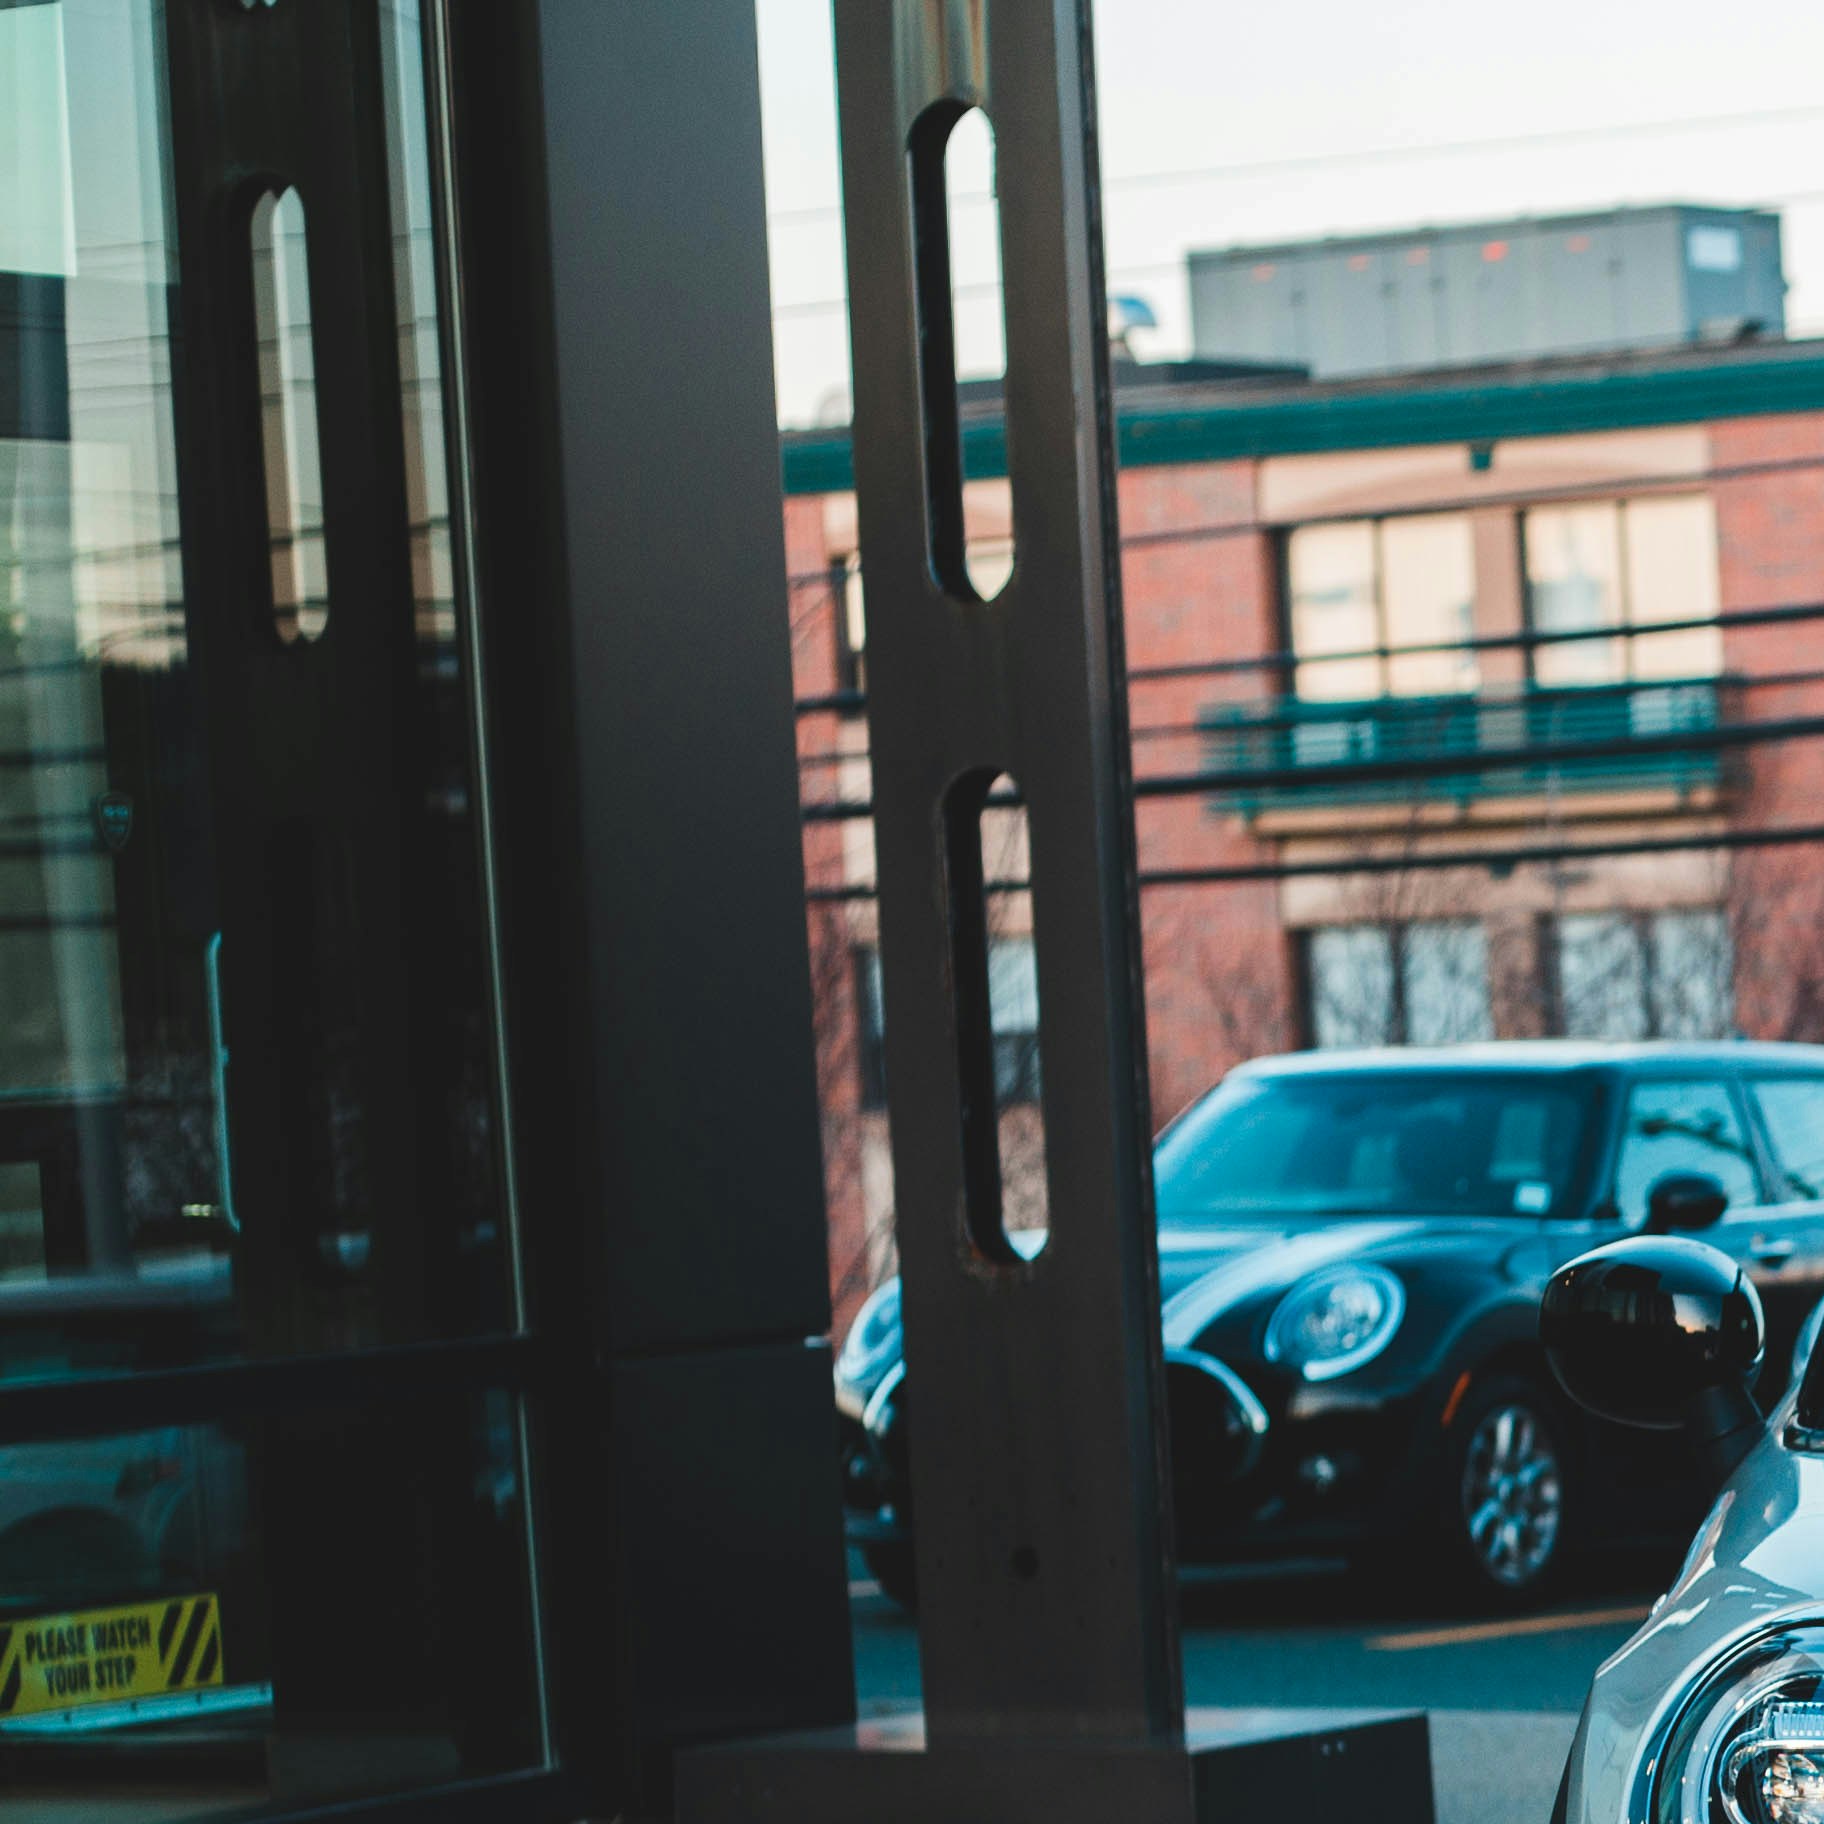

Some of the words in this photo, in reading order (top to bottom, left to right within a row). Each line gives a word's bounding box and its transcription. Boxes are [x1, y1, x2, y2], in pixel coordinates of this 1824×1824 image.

[25, 1622, 88, 1663] PLEASE
[91, 1615, 150, 1652] WATCH
[44, 1662, 91, 1697] YOUR
[94, 1654, 136, 1691] STEP
